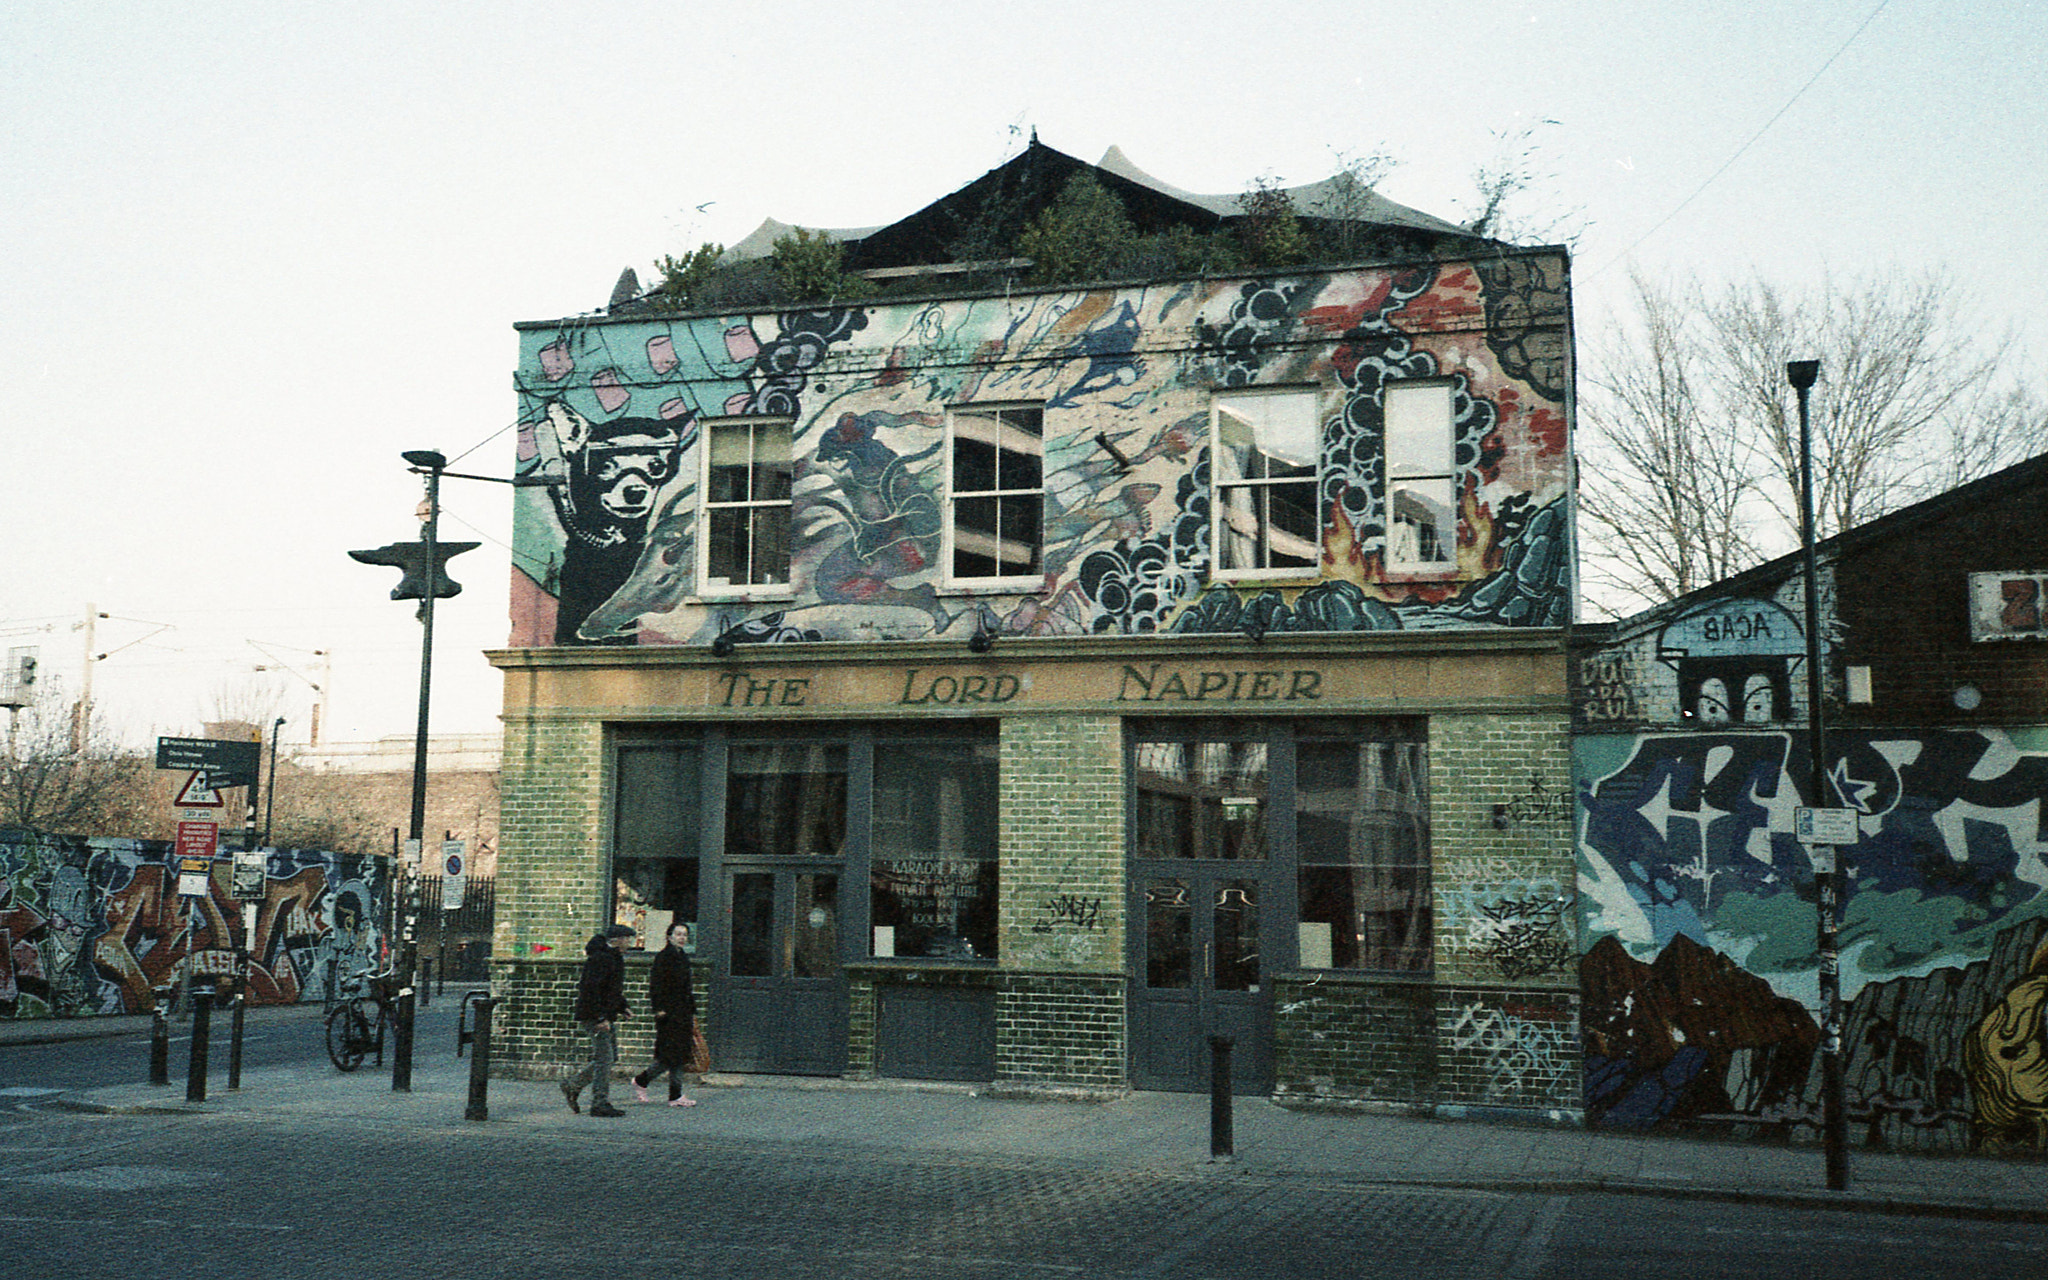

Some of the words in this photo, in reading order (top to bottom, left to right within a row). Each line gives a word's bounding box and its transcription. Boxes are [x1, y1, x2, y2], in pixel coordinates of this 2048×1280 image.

[719, 672, 810, 707] THE
[899, 669, 1021, 705] LORD
[1117, 663, 1323, 701] NAPIER
[892, 860, 944, 875] KARAOKE
